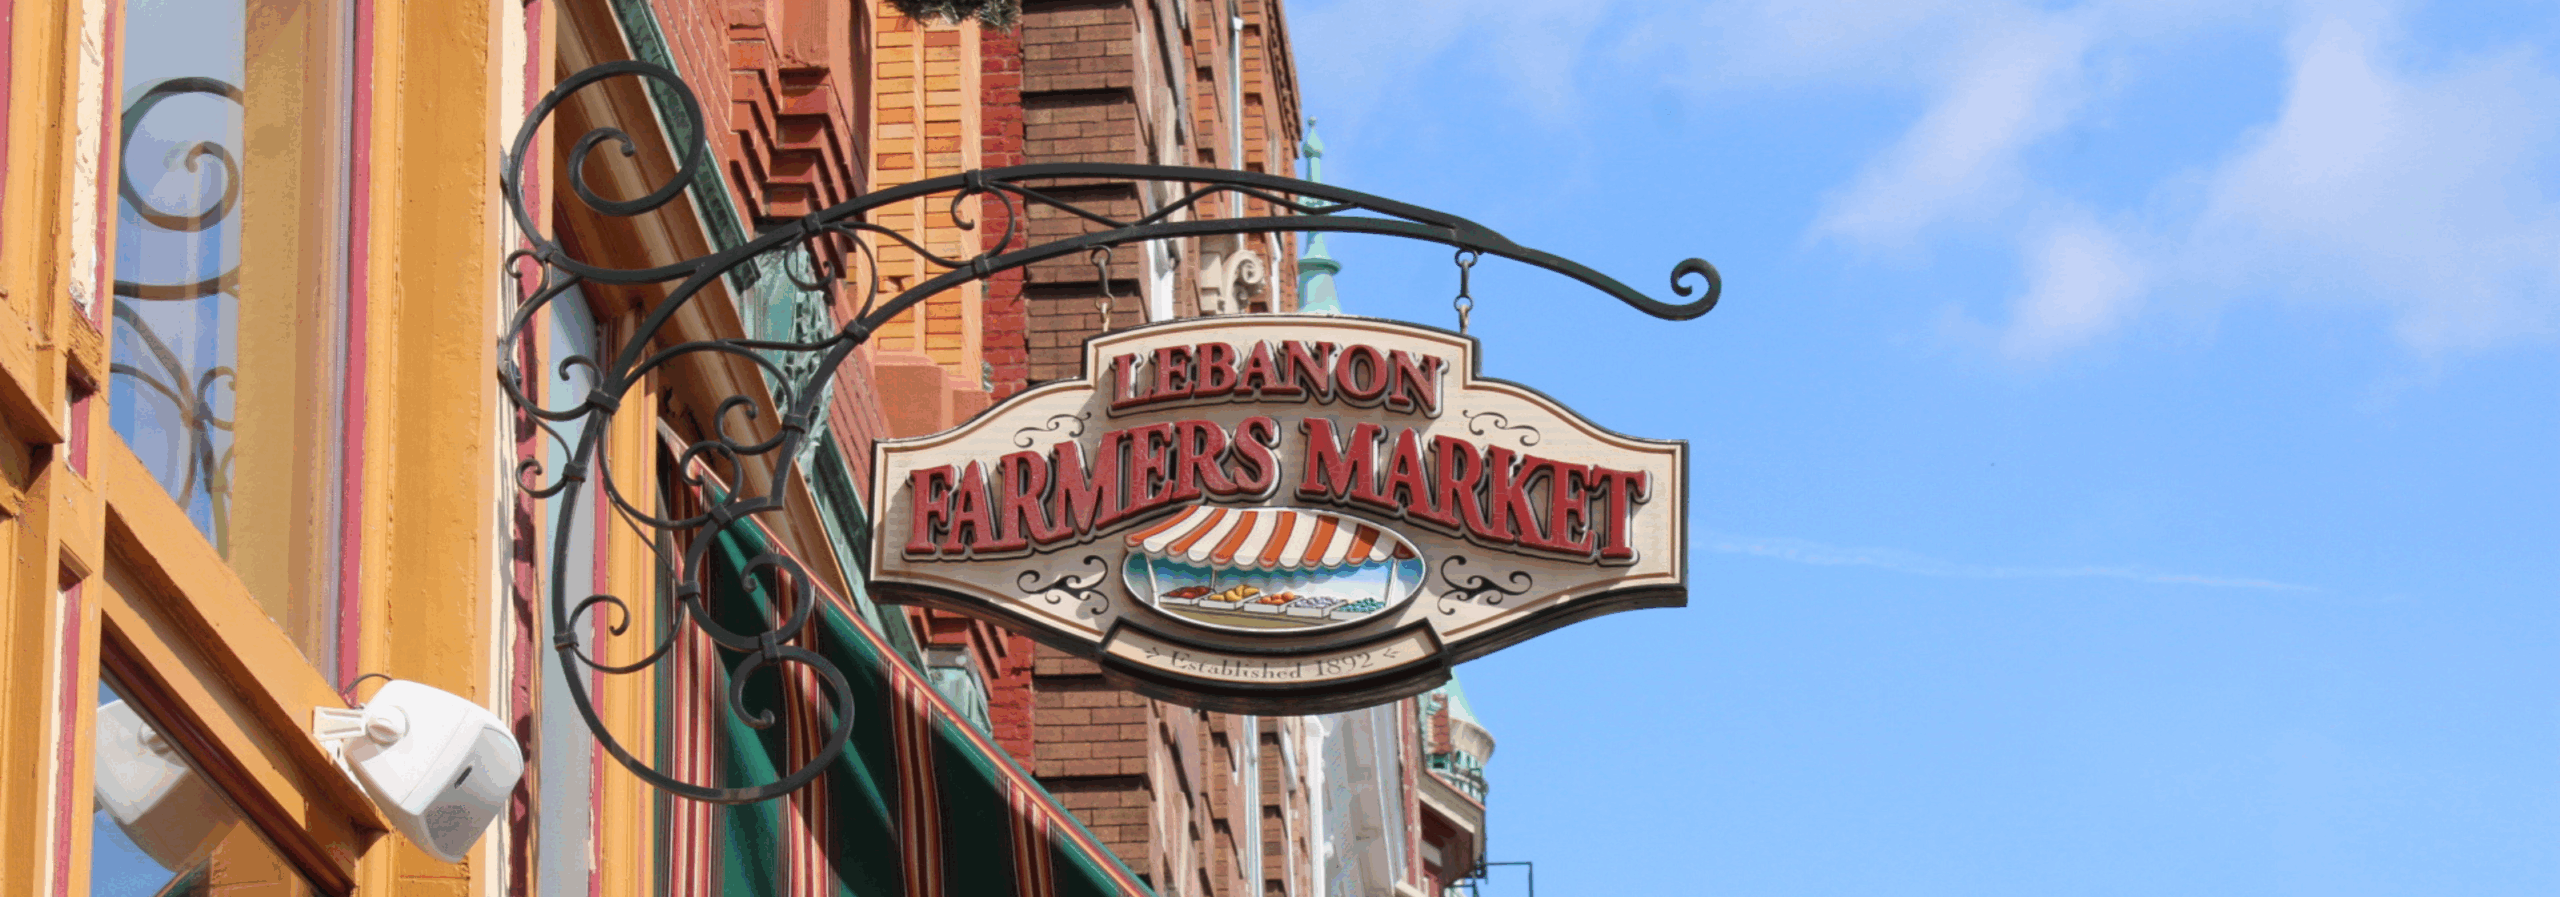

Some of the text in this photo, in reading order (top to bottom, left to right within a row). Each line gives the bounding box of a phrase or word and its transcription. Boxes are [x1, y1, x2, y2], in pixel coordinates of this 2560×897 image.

[1112, 340, 1441, 410] LEBANON
[904, 415, 1646, 559] FARMERS MARKET
[1169, 650, 1373, 681] Established 1892
